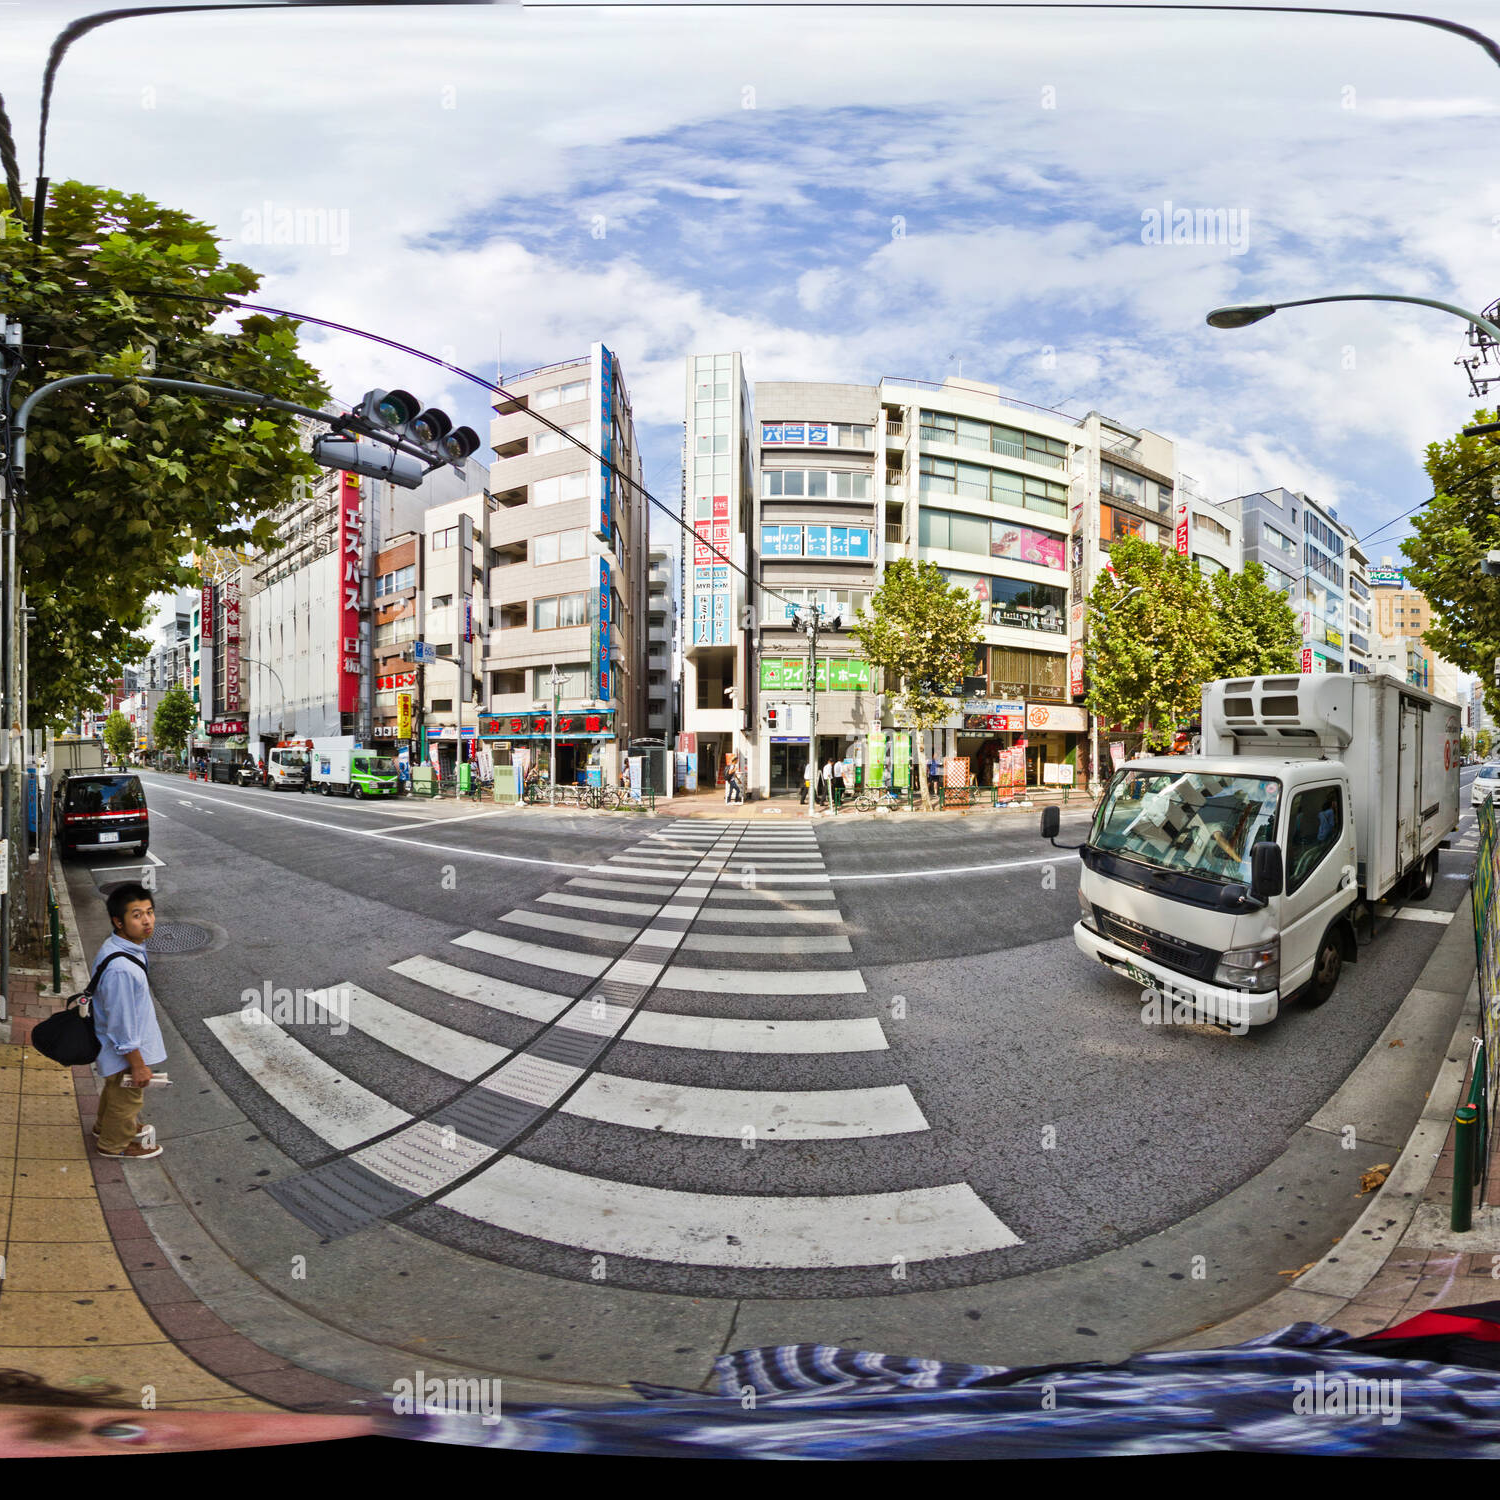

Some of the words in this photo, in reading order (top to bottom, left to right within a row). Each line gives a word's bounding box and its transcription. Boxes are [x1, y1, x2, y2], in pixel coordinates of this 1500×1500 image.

[489, 716, 600, 733] カラオケ館
